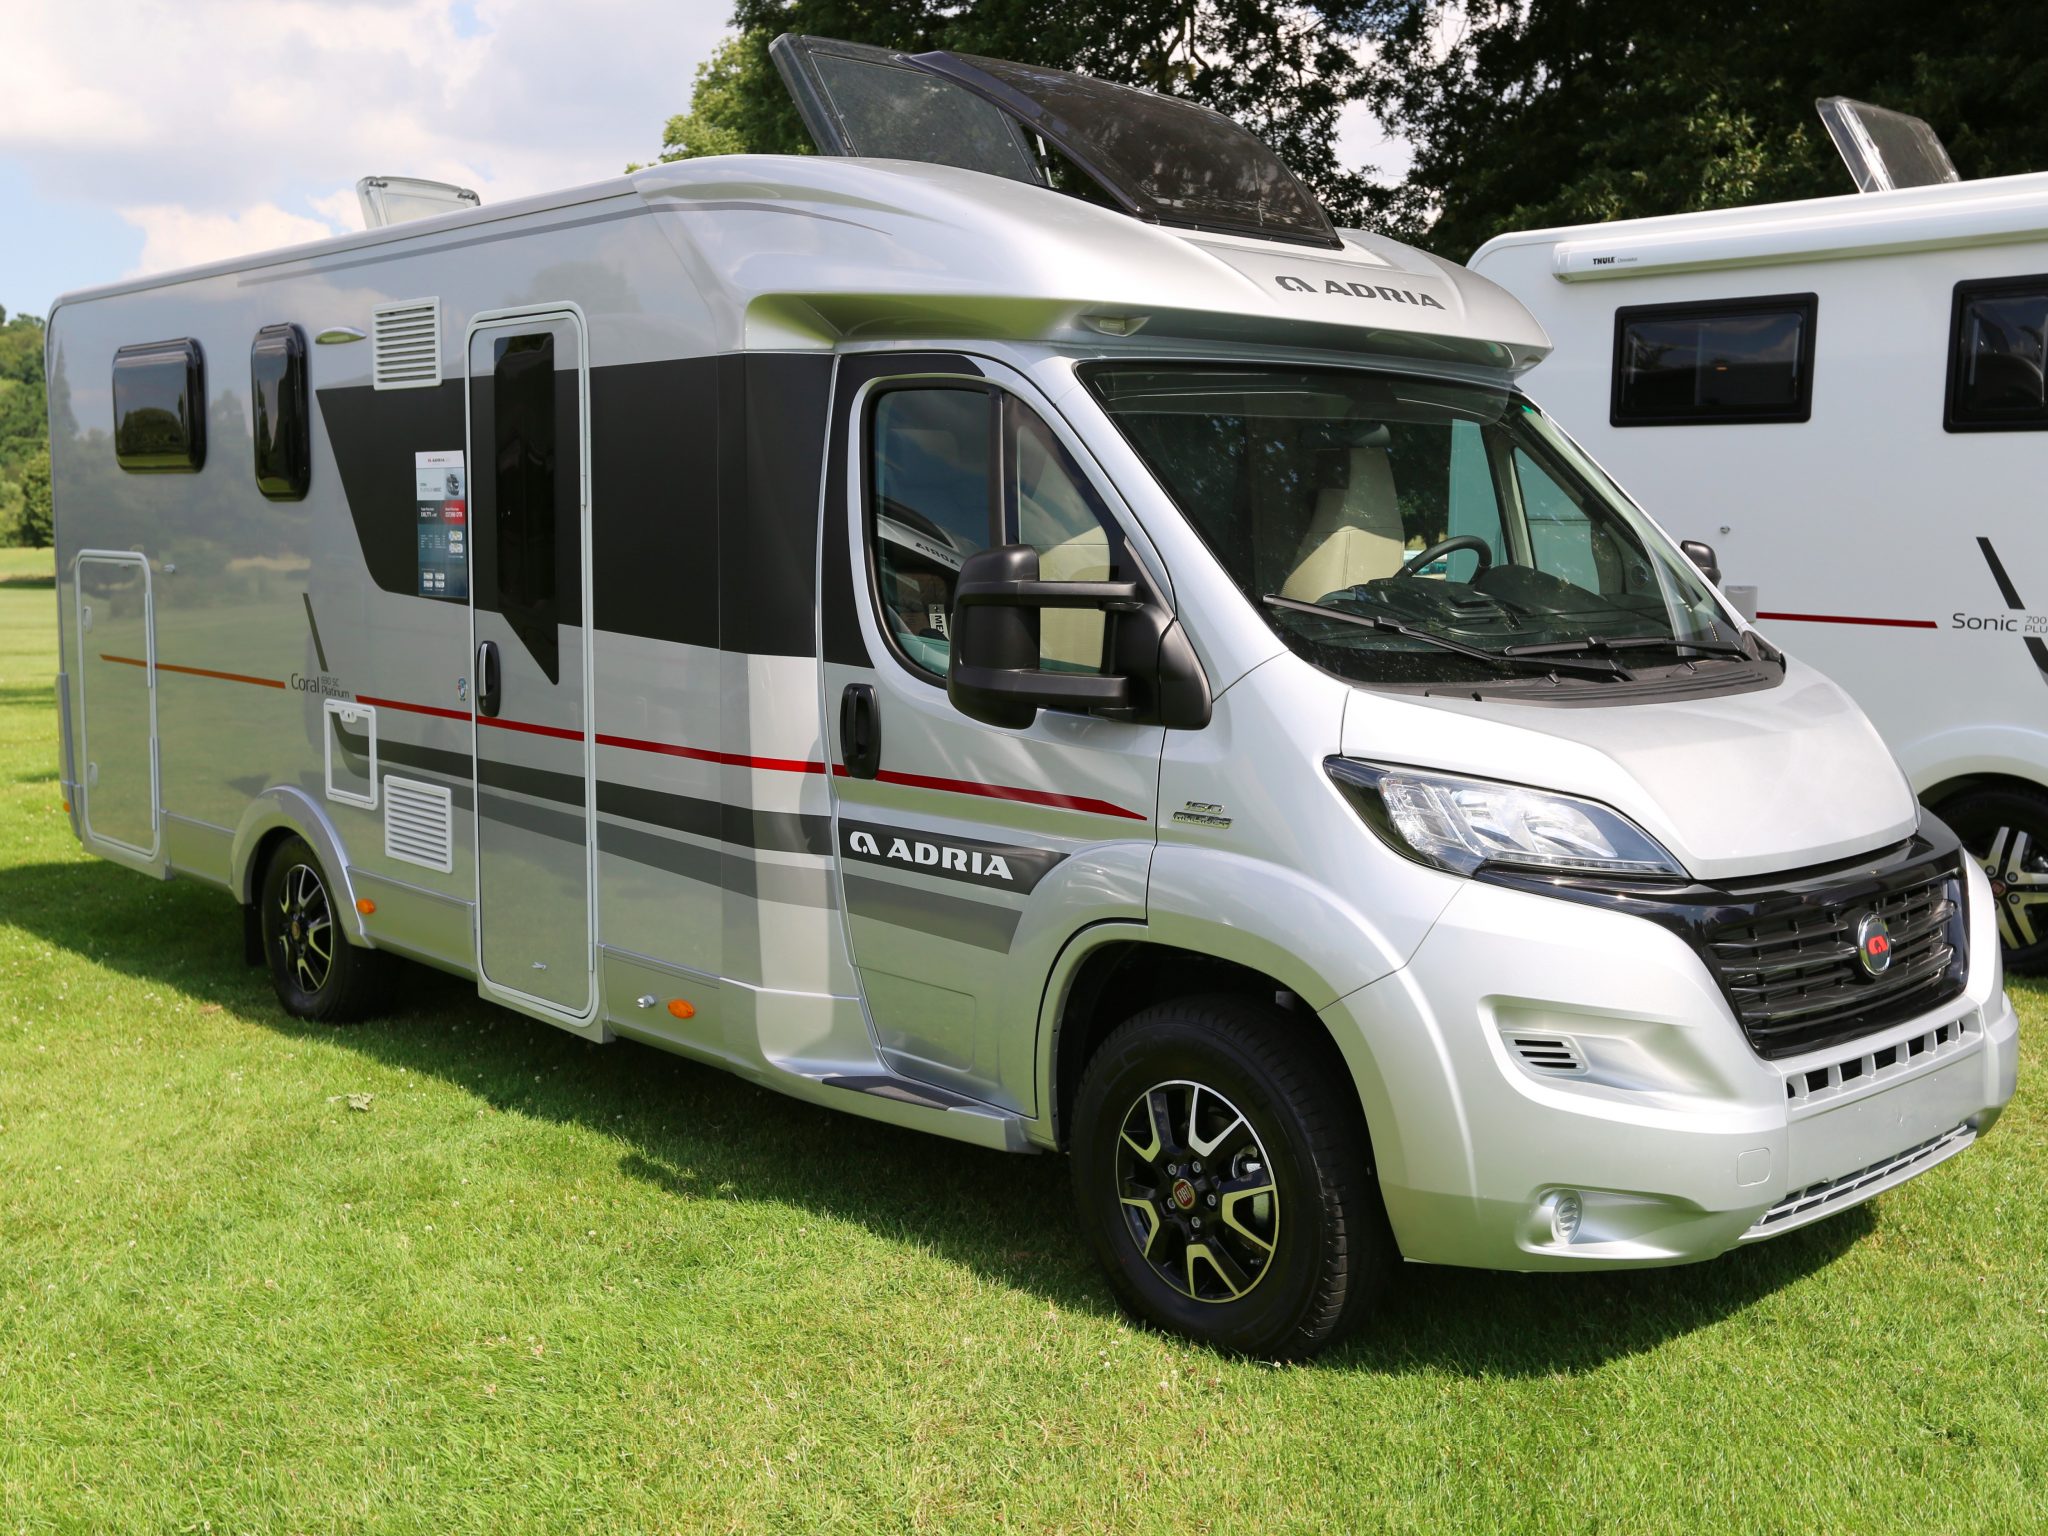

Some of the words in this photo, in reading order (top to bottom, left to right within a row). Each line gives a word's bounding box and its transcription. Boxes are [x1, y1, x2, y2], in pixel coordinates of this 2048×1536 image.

[1592, 256, 1616, 265] THULE
[1323, 279, 1447, 311] ADRIA
[1951, 612, 2018, 632] Sonic
[2025, 615, 2048, 625] 700
[290, 672, 320, 694] Coral
[321, 685, 350, 699] Platinum
[886, 837, 1014, 881] ADRIA
